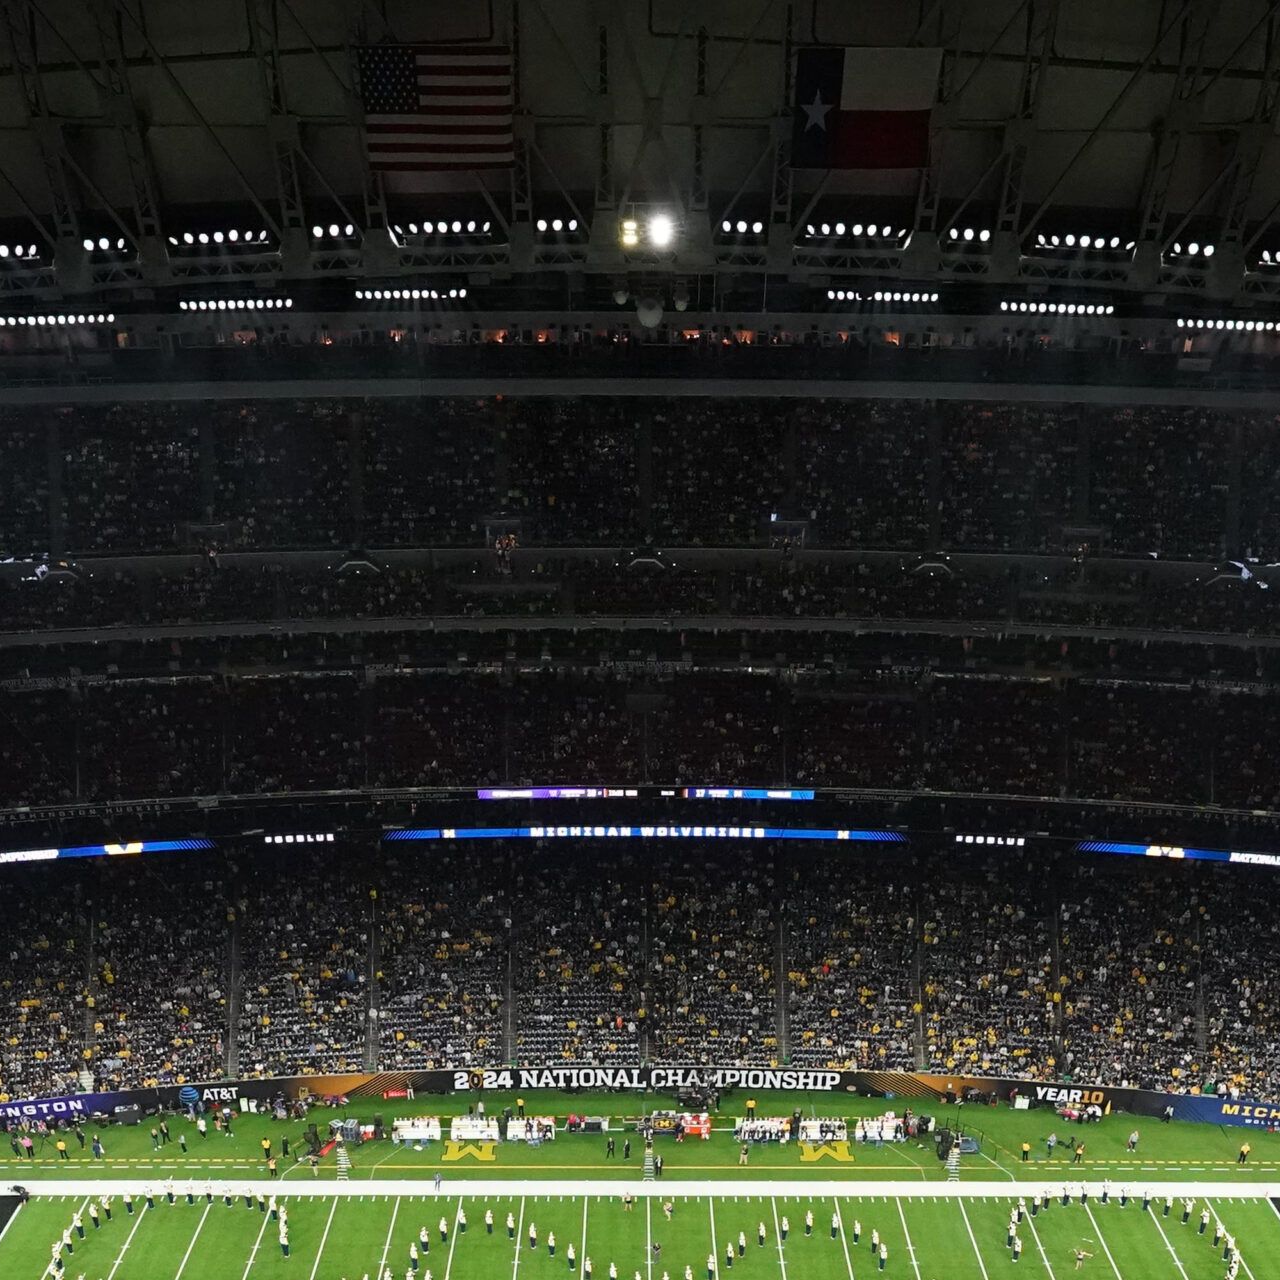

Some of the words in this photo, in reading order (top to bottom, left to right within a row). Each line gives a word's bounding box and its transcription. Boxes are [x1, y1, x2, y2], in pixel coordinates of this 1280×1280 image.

[530, 827, 631, 838] MICHIGAN
[640, 827, 765, 838] WOLVERINES
[520, 1068, 647, 1089] NATIONAL
[202, 1087, 239, 1101] AT&T
